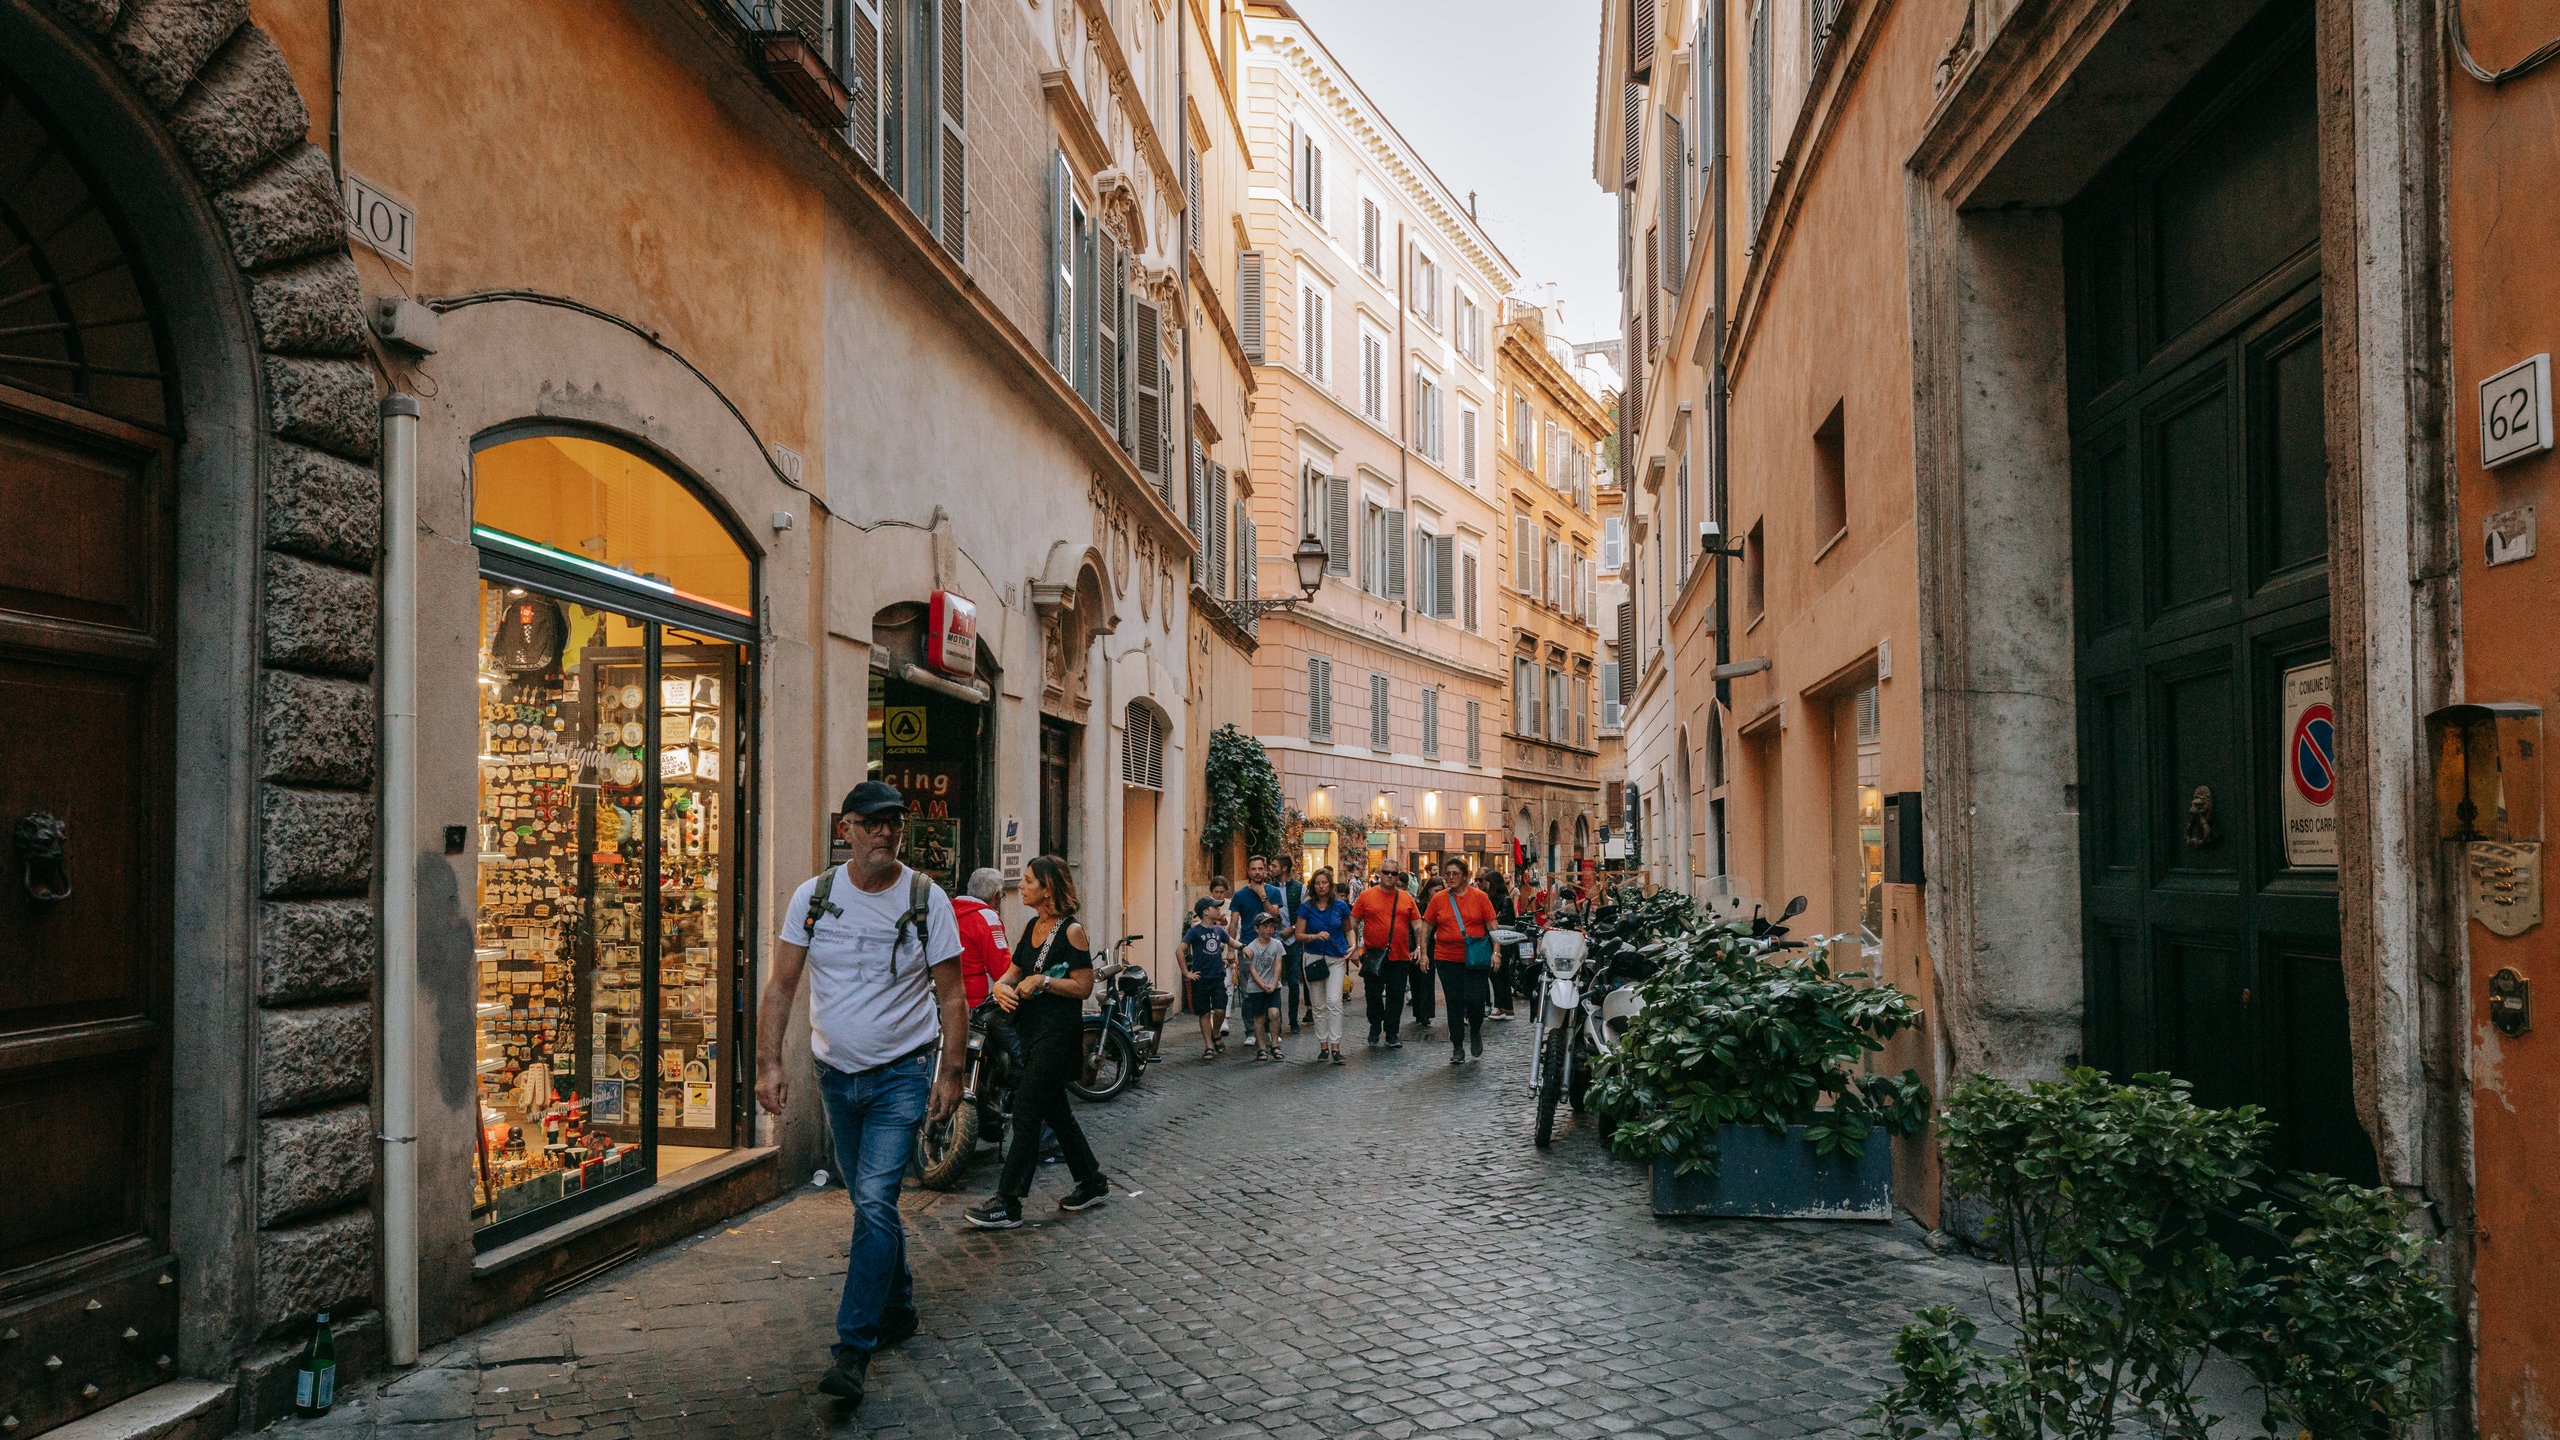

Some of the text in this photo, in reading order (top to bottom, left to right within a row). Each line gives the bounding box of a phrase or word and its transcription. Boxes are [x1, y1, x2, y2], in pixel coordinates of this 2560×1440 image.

[2489, 387, 2530, 441] 62
[2298, 677, 2324, 695] COMUNE
[2290, 818, 2314, 833] PASSO
